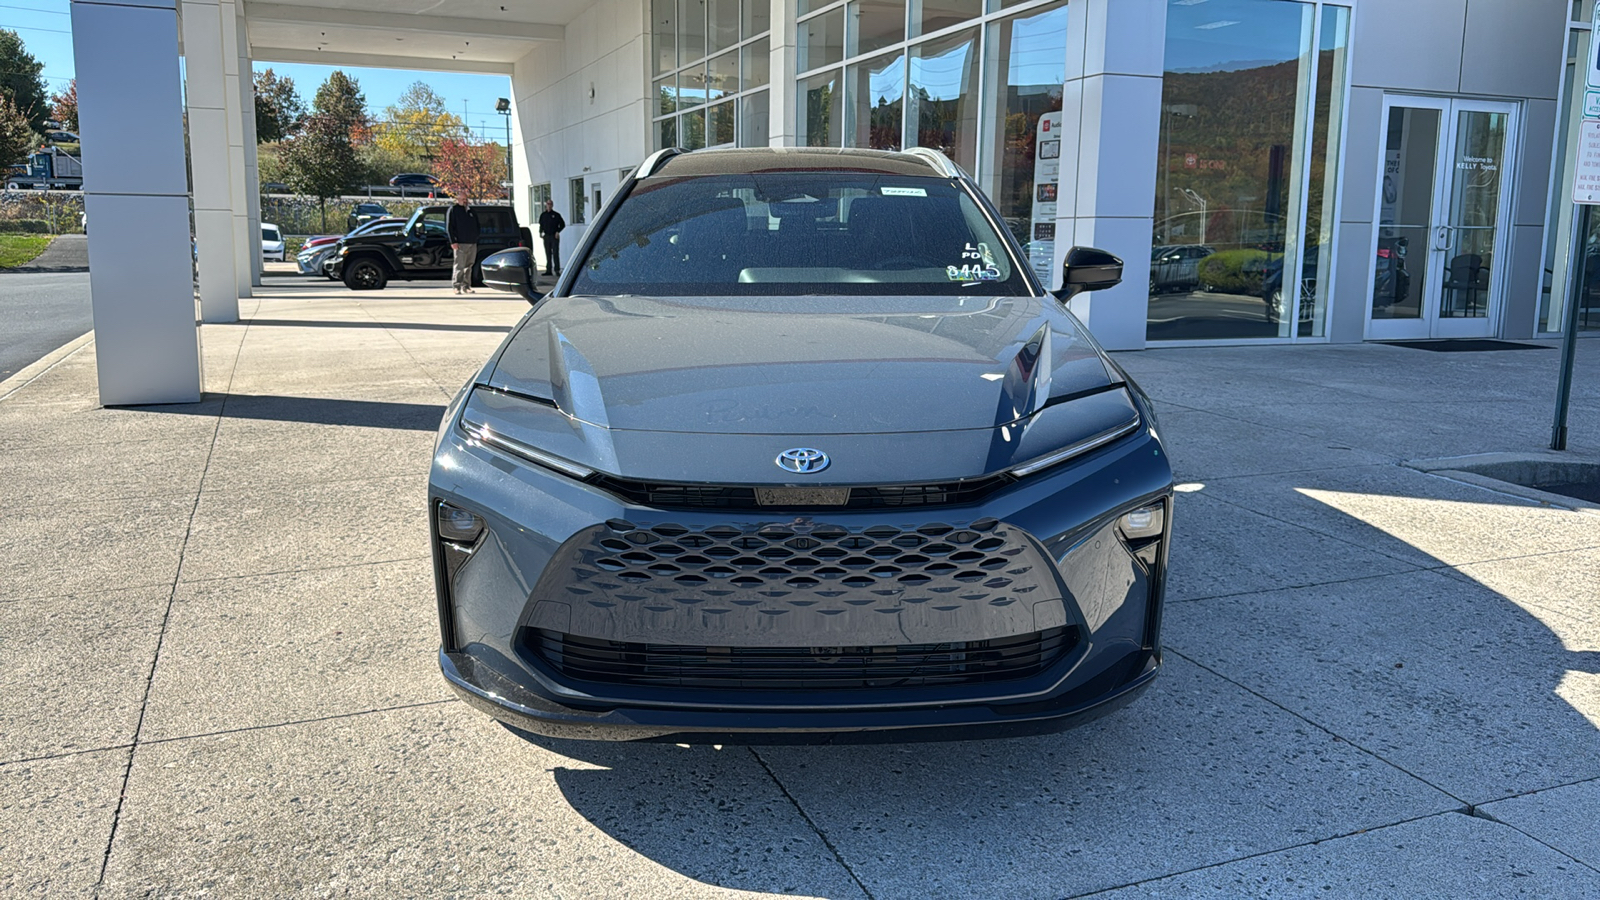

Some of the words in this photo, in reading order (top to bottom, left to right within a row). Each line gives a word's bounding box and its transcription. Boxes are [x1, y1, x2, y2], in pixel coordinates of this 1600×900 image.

[1463, 155, 1486, 163] Welcome
[1456, 162, 1477, 170] KELLY
[1480, 163, 1497, 171] Toyota
[946, 264, 1001, 278] 8445
